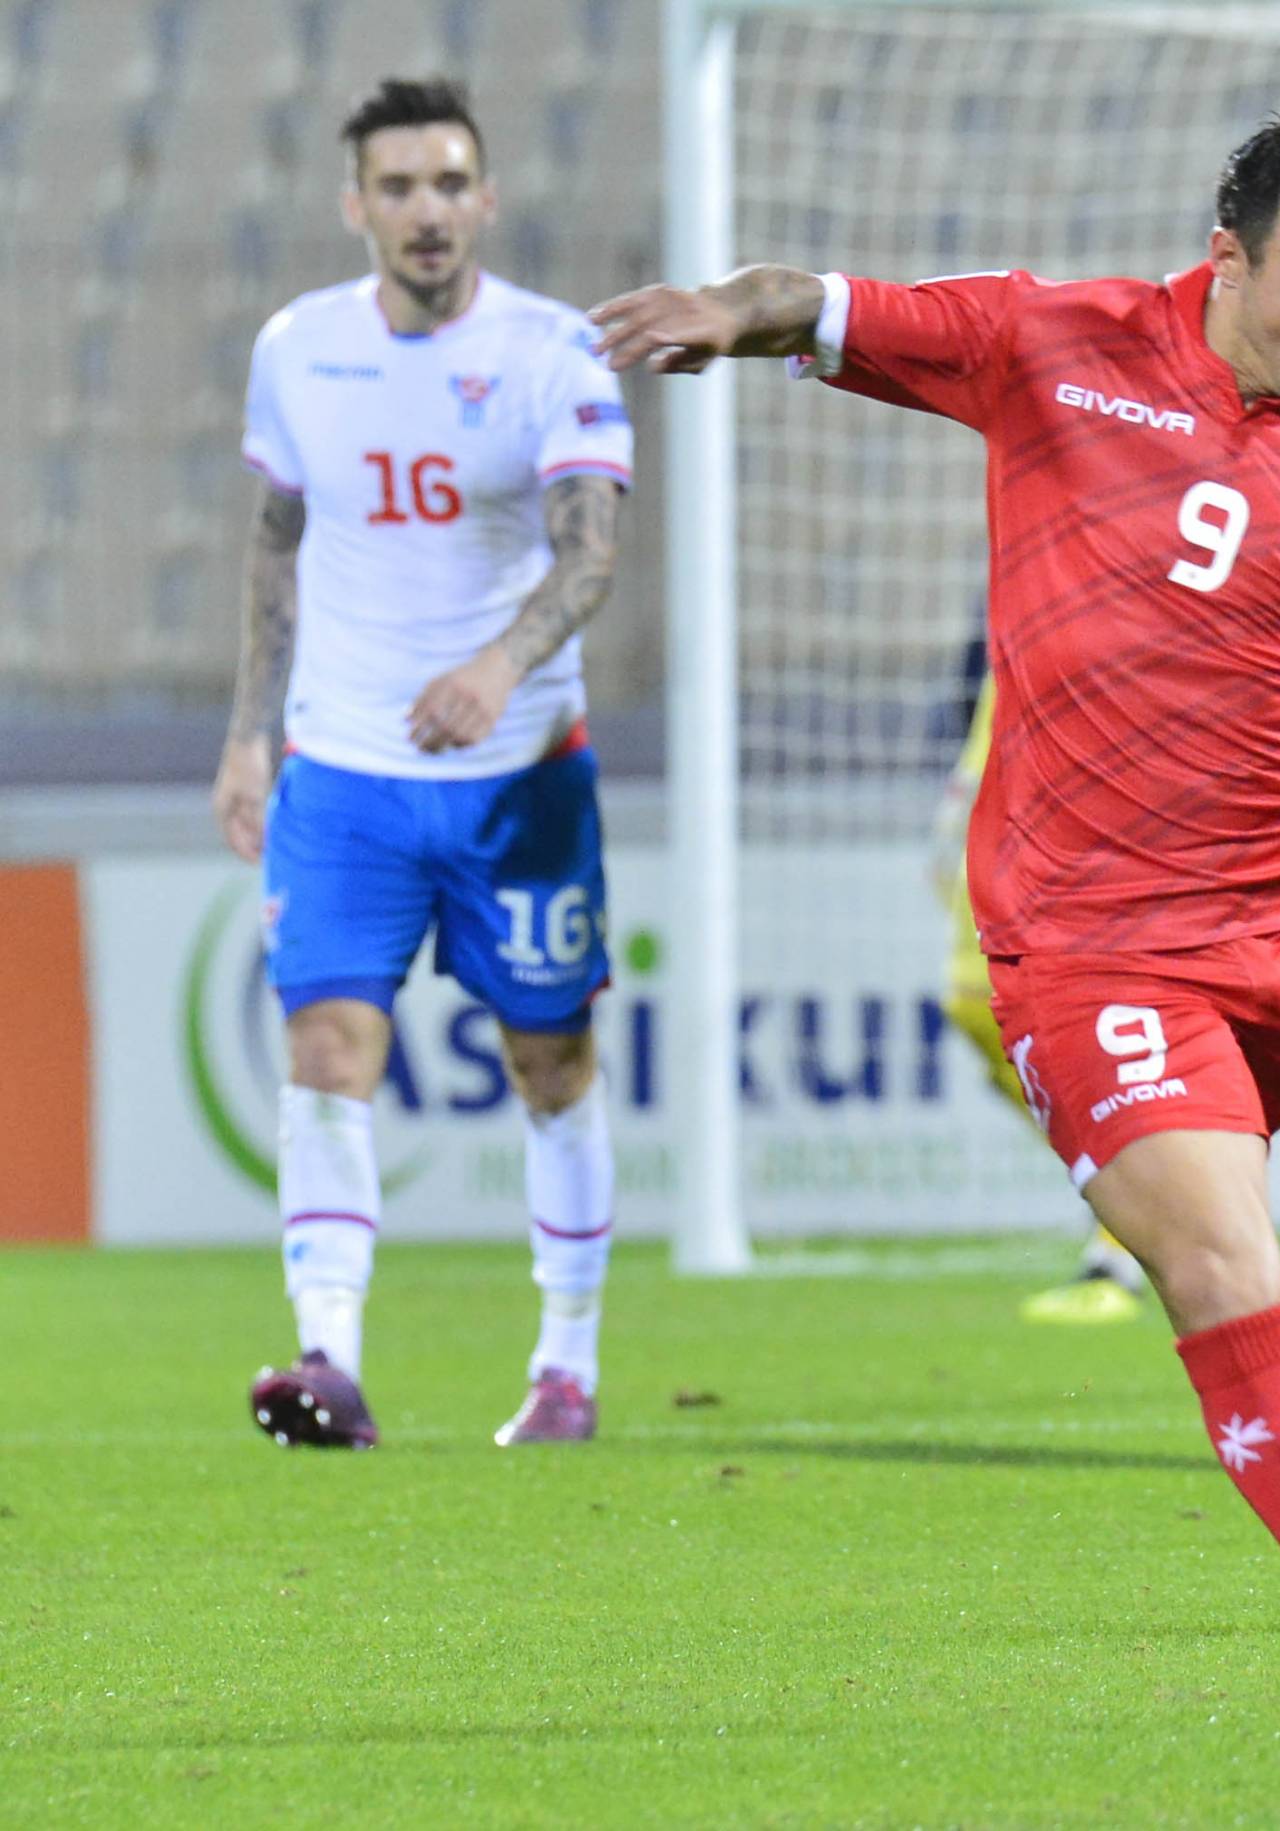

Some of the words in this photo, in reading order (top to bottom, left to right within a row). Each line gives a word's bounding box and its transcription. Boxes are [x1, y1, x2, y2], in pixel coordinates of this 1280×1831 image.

[1055, 382, 1196, 436] GIVOVA
[364, 451, 464, 525] 16
[1166, 480, 1250, 593] 9
[495, 885, 592, 965] 16
[1094, 1002, 1169, 1086] 9
[1089, 1077, 1188, 1123] GIVOVA
